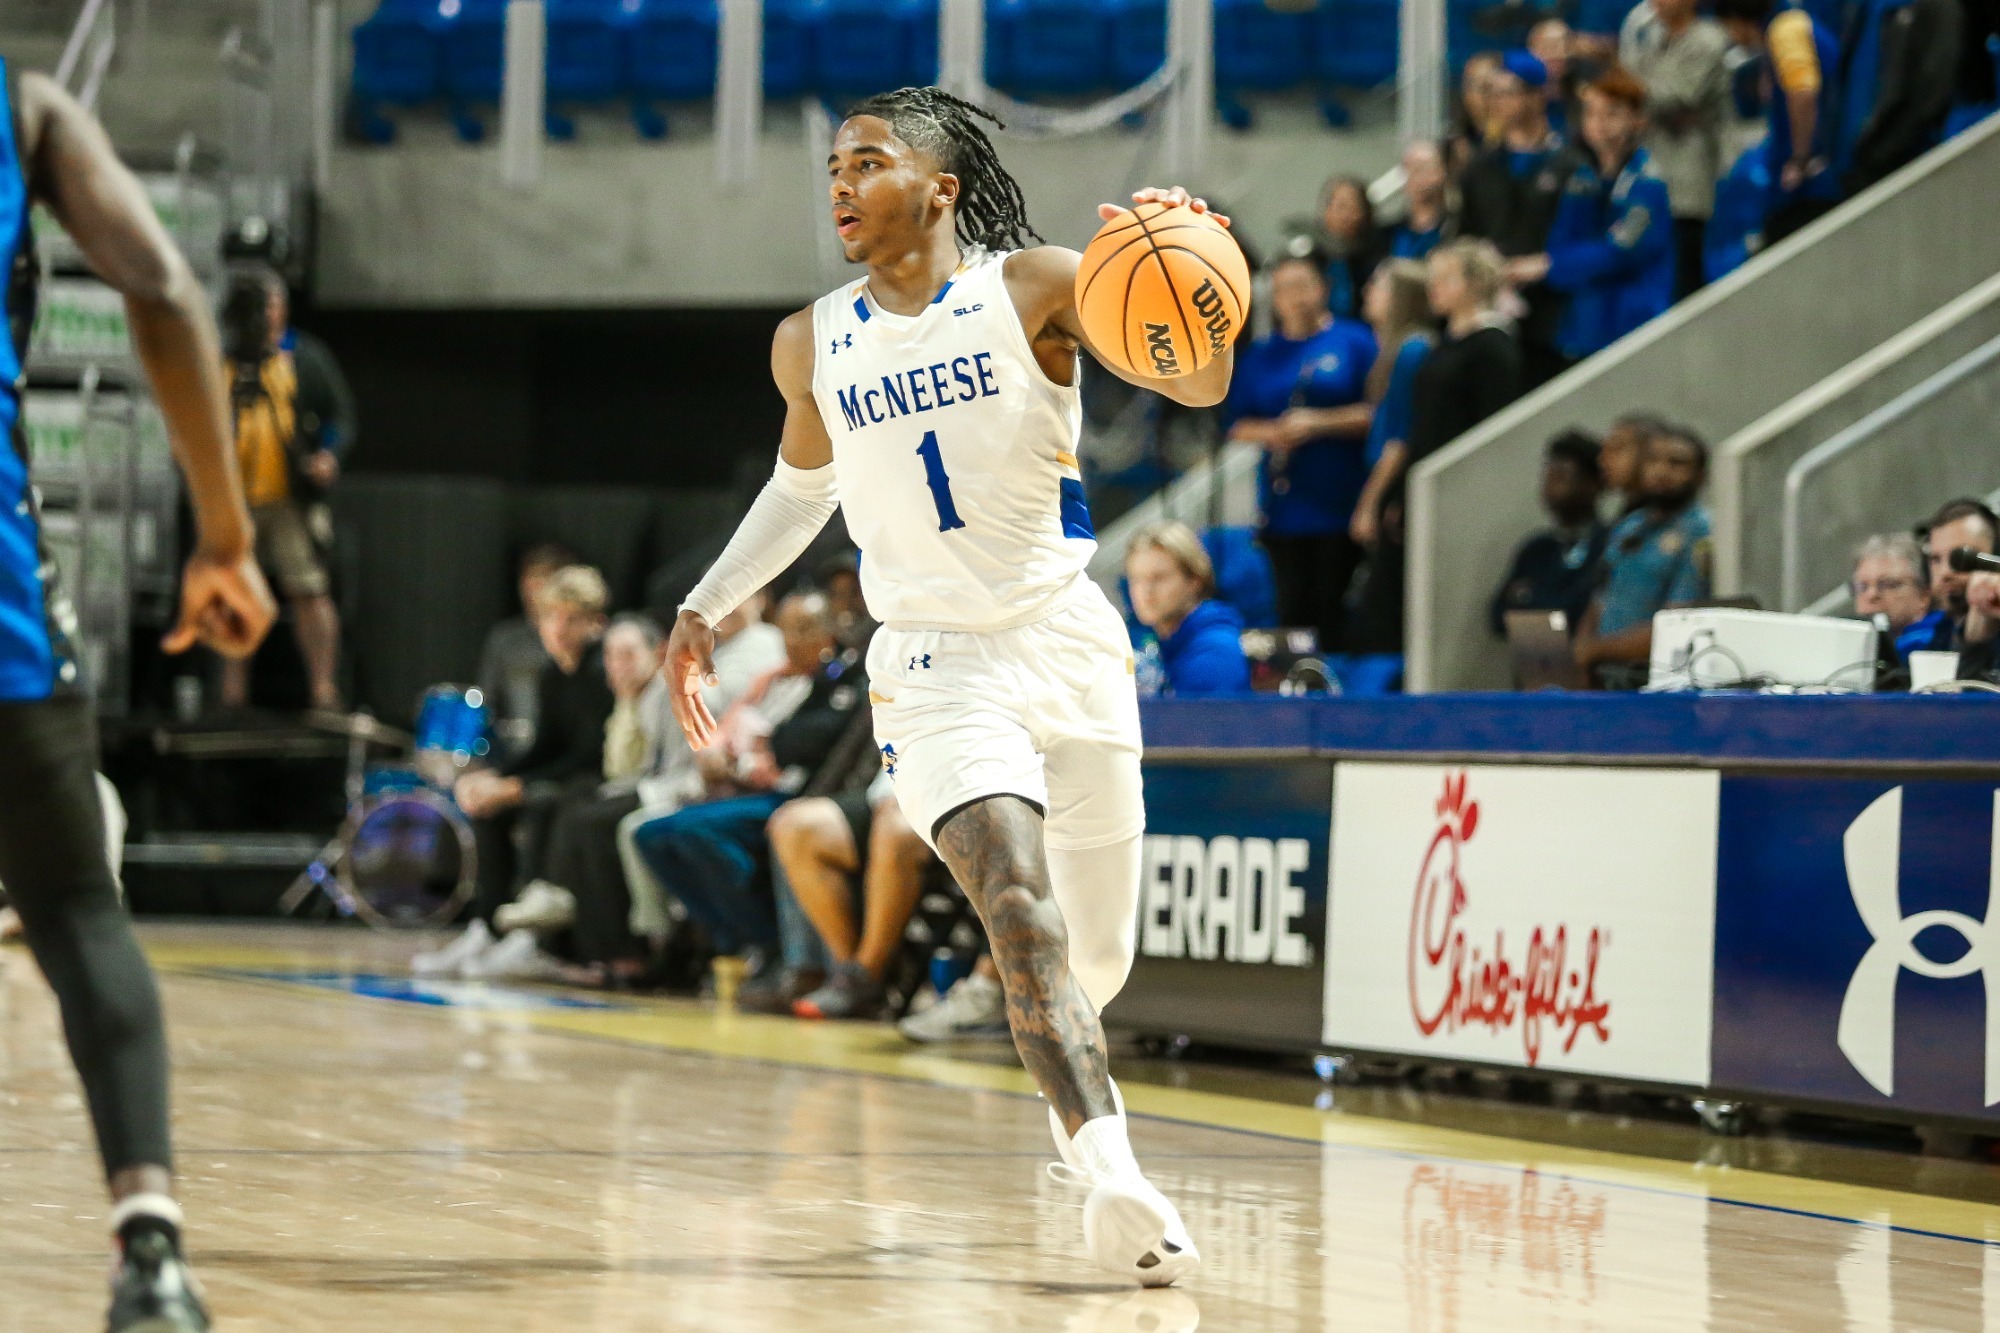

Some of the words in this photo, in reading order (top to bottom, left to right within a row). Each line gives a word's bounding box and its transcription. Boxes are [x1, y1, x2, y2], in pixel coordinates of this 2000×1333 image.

[953, 303, 984, 317] SLC
[1192, 277, 1231, 356] Wilso
[837, 352, 1000, 431] McNEESE
[915, 430, 966, 533] 1
[1136, 834, 1310, 967] ERADE
